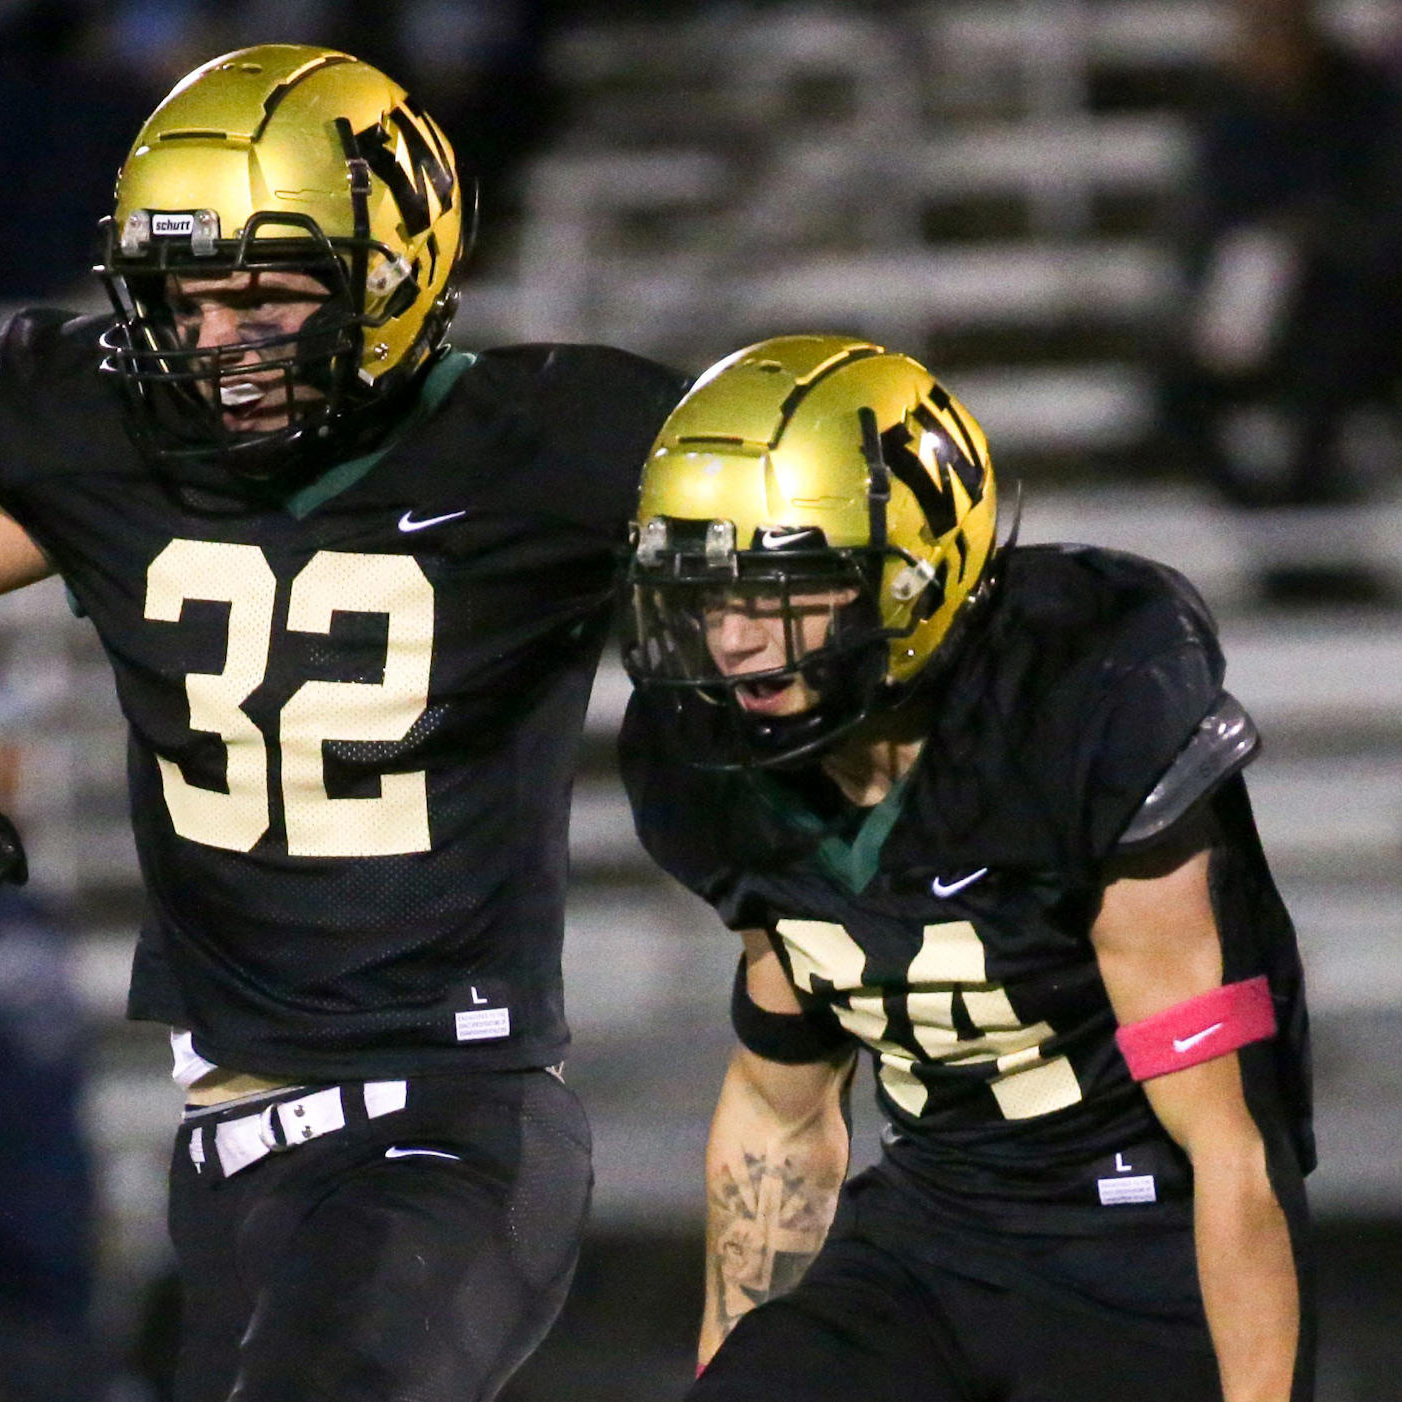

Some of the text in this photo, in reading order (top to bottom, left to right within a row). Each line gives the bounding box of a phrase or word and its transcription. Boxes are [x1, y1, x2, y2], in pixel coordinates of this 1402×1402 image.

[156, 219, 191, 231] schutt
[144, 538, 435, 858] 32
[471, 986, 488, 1004] L
[776, 919, 1083, 1120] 34
[1115, 1152, 1132, 1172] L
